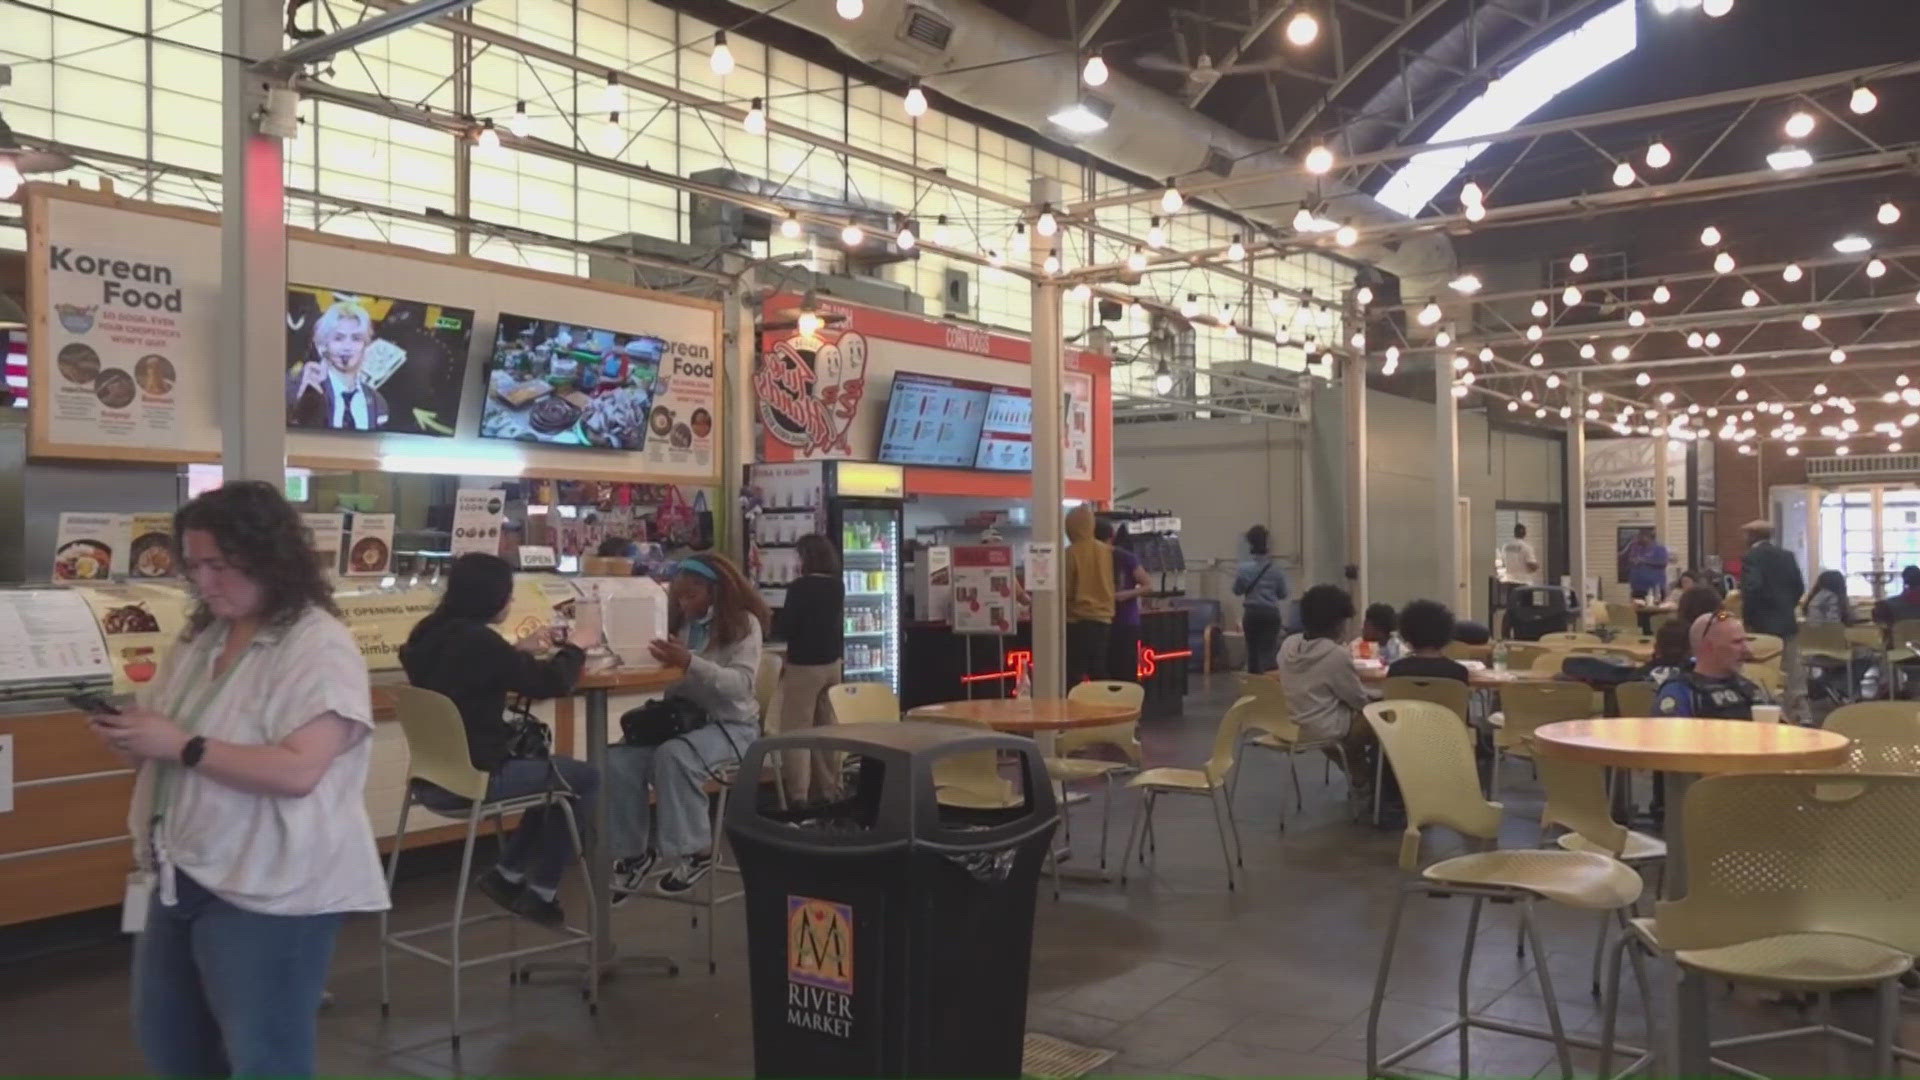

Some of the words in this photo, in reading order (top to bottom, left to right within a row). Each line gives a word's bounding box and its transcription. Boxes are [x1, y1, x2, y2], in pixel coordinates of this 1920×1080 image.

[50, 245, 172, 285] Korean
[103, 280, 182, 313] Food
[660, 341, 709, 359] orean
[946, 328, 968, 350] CORN
[968, 331, 990, 353] DOGS
[673, 357, 713, 378] Food
[1623, 476, 1675, 488] VISITR
[1586, 488, 1675, 500] NFORMATIN
[524, 555, 552, 564] OPEN
[353, 605, 404, 616] OPENING
[788, 982, 854, 1020] RIVER
[787, 1008, 853, 1039] MARKET
